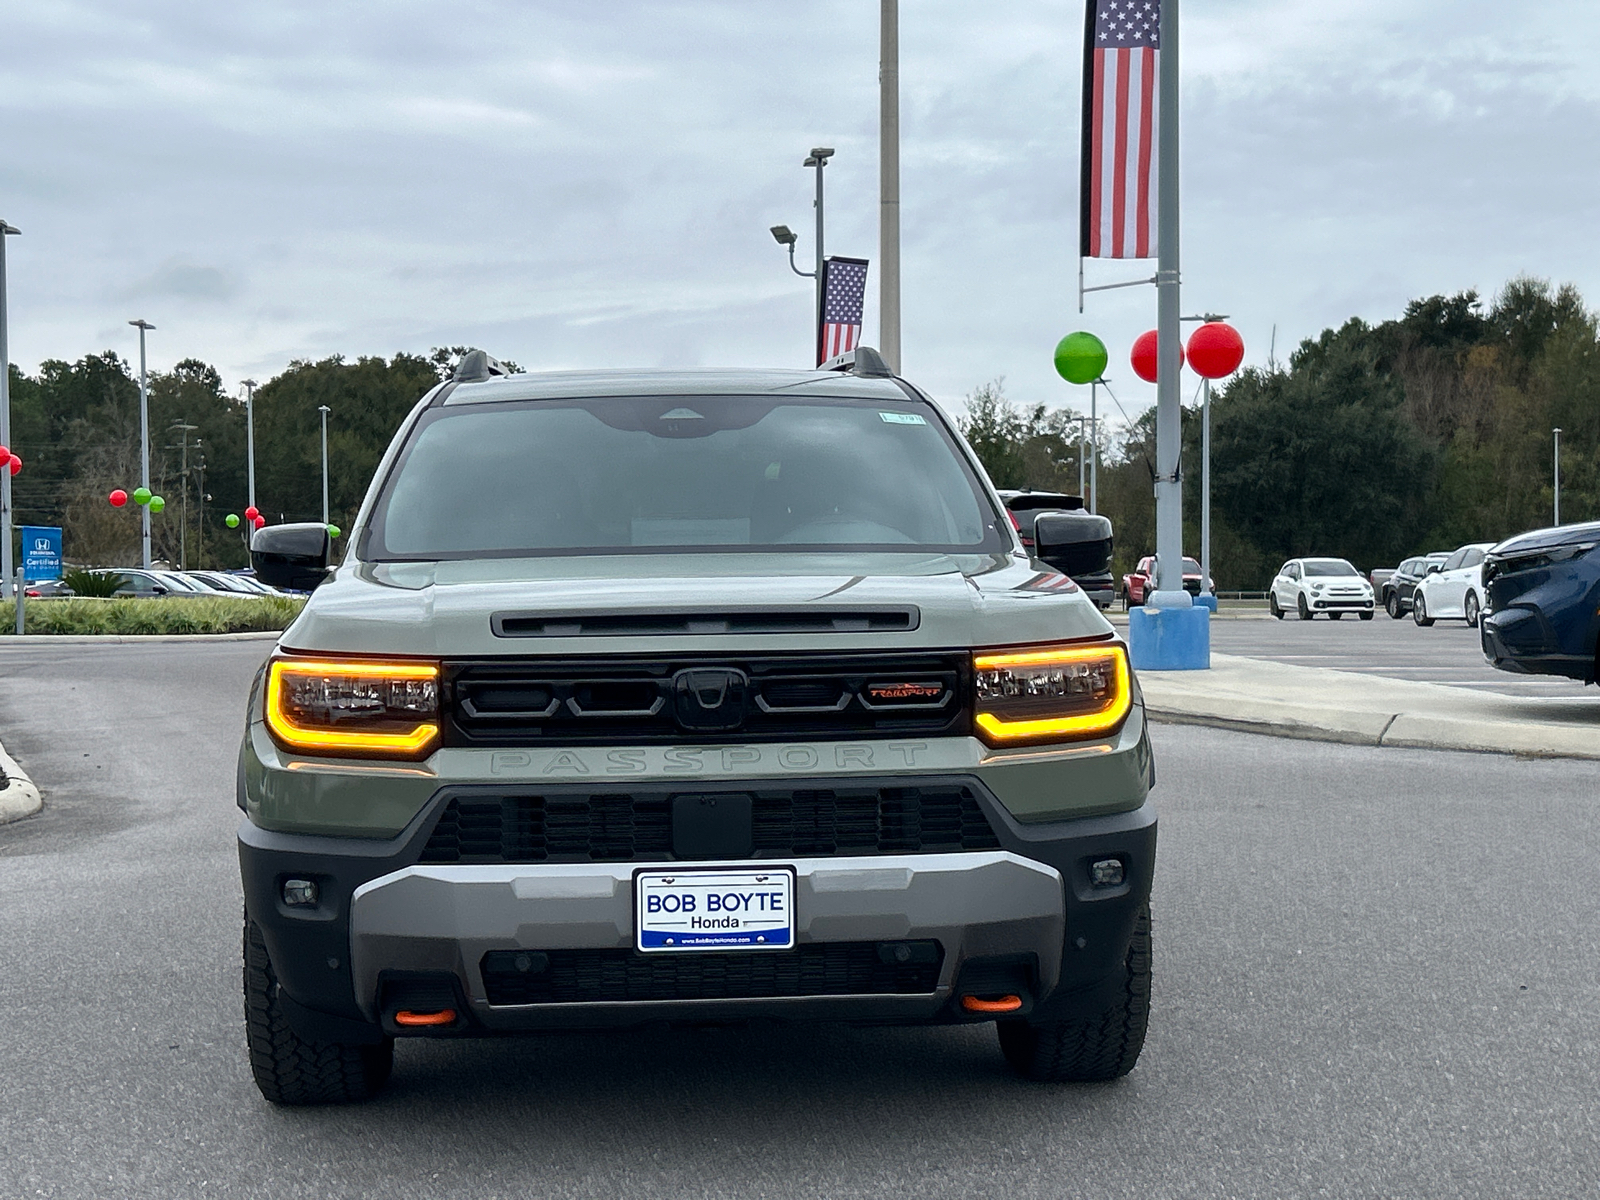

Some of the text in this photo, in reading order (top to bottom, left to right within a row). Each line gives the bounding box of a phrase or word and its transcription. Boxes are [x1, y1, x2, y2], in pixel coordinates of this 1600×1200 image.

[26, 558, 60, 566] Certified
[870, 688, 941, 698] TRAILSPORT
[490, 742, 929, 775] PASSPORT
[647, 892, 784, 913] BOB BOYTE
[691, 916, 740, 929] Honda
